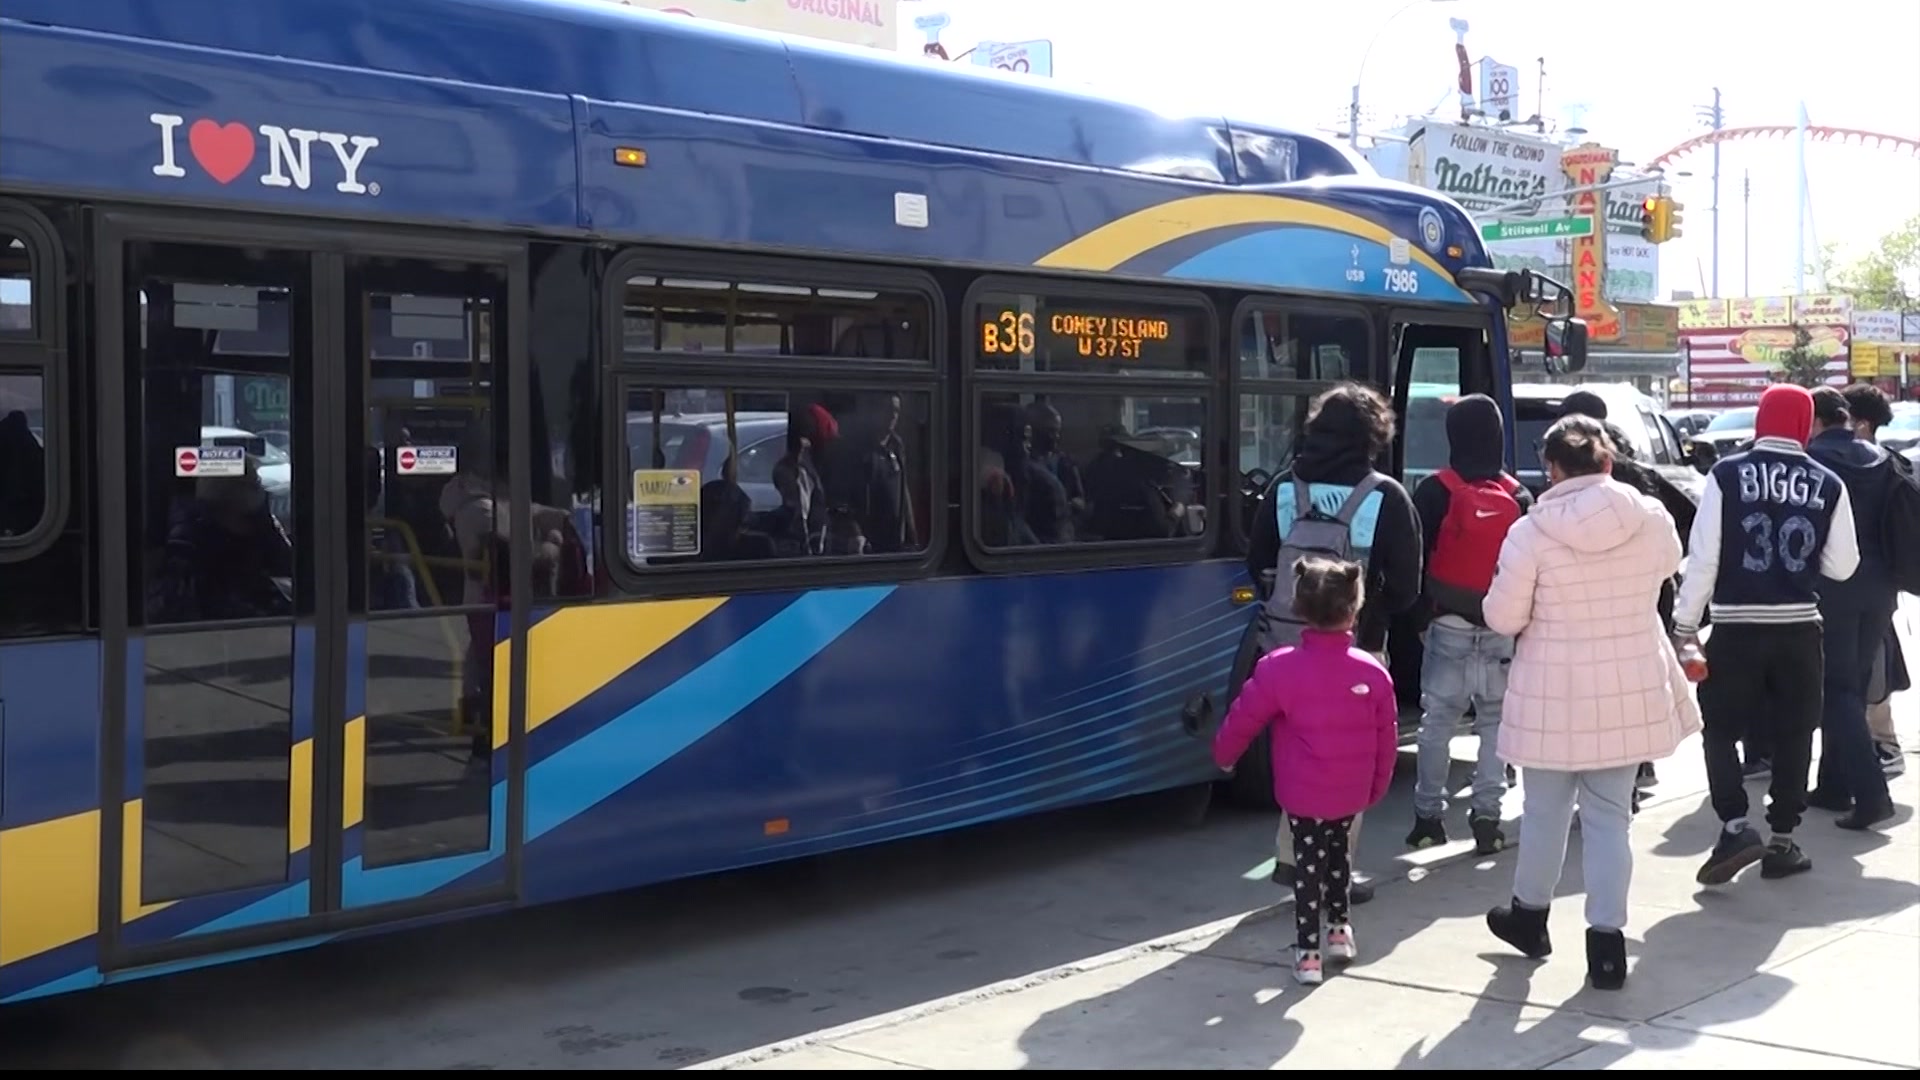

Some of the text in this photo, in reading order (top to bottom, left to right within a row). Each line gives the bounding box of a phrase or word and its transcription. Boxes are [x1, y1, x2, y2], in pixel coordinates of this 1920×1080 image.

[787, 0, 883, 26] ORIGINAL
[150, 113, 186, 178] I
[1450, 133, 1546, 163] FOLLOW THE CROWD
[1435, 156, 1547, 200] Nathan's
[1500, 222, 1572, 237] Stillwell Av
[1578, 167, 1596, 309] NAHANS
[1346, 269, 1366, 282] USB
[1382, 268, 1418, 294] 7986
[983, 310, 1170, 356] B36 CONEY ISLAND
[1095, 338, 1118, 357] 37
[1121, 339, 1143, 358] ST
[201, 448, 240, 459] NOTICE
[419, 448, 450, 458] NOTICE
[1738, 462, 1825, 510] BIGGZ
[1741, 512, 1817, 572] 30
